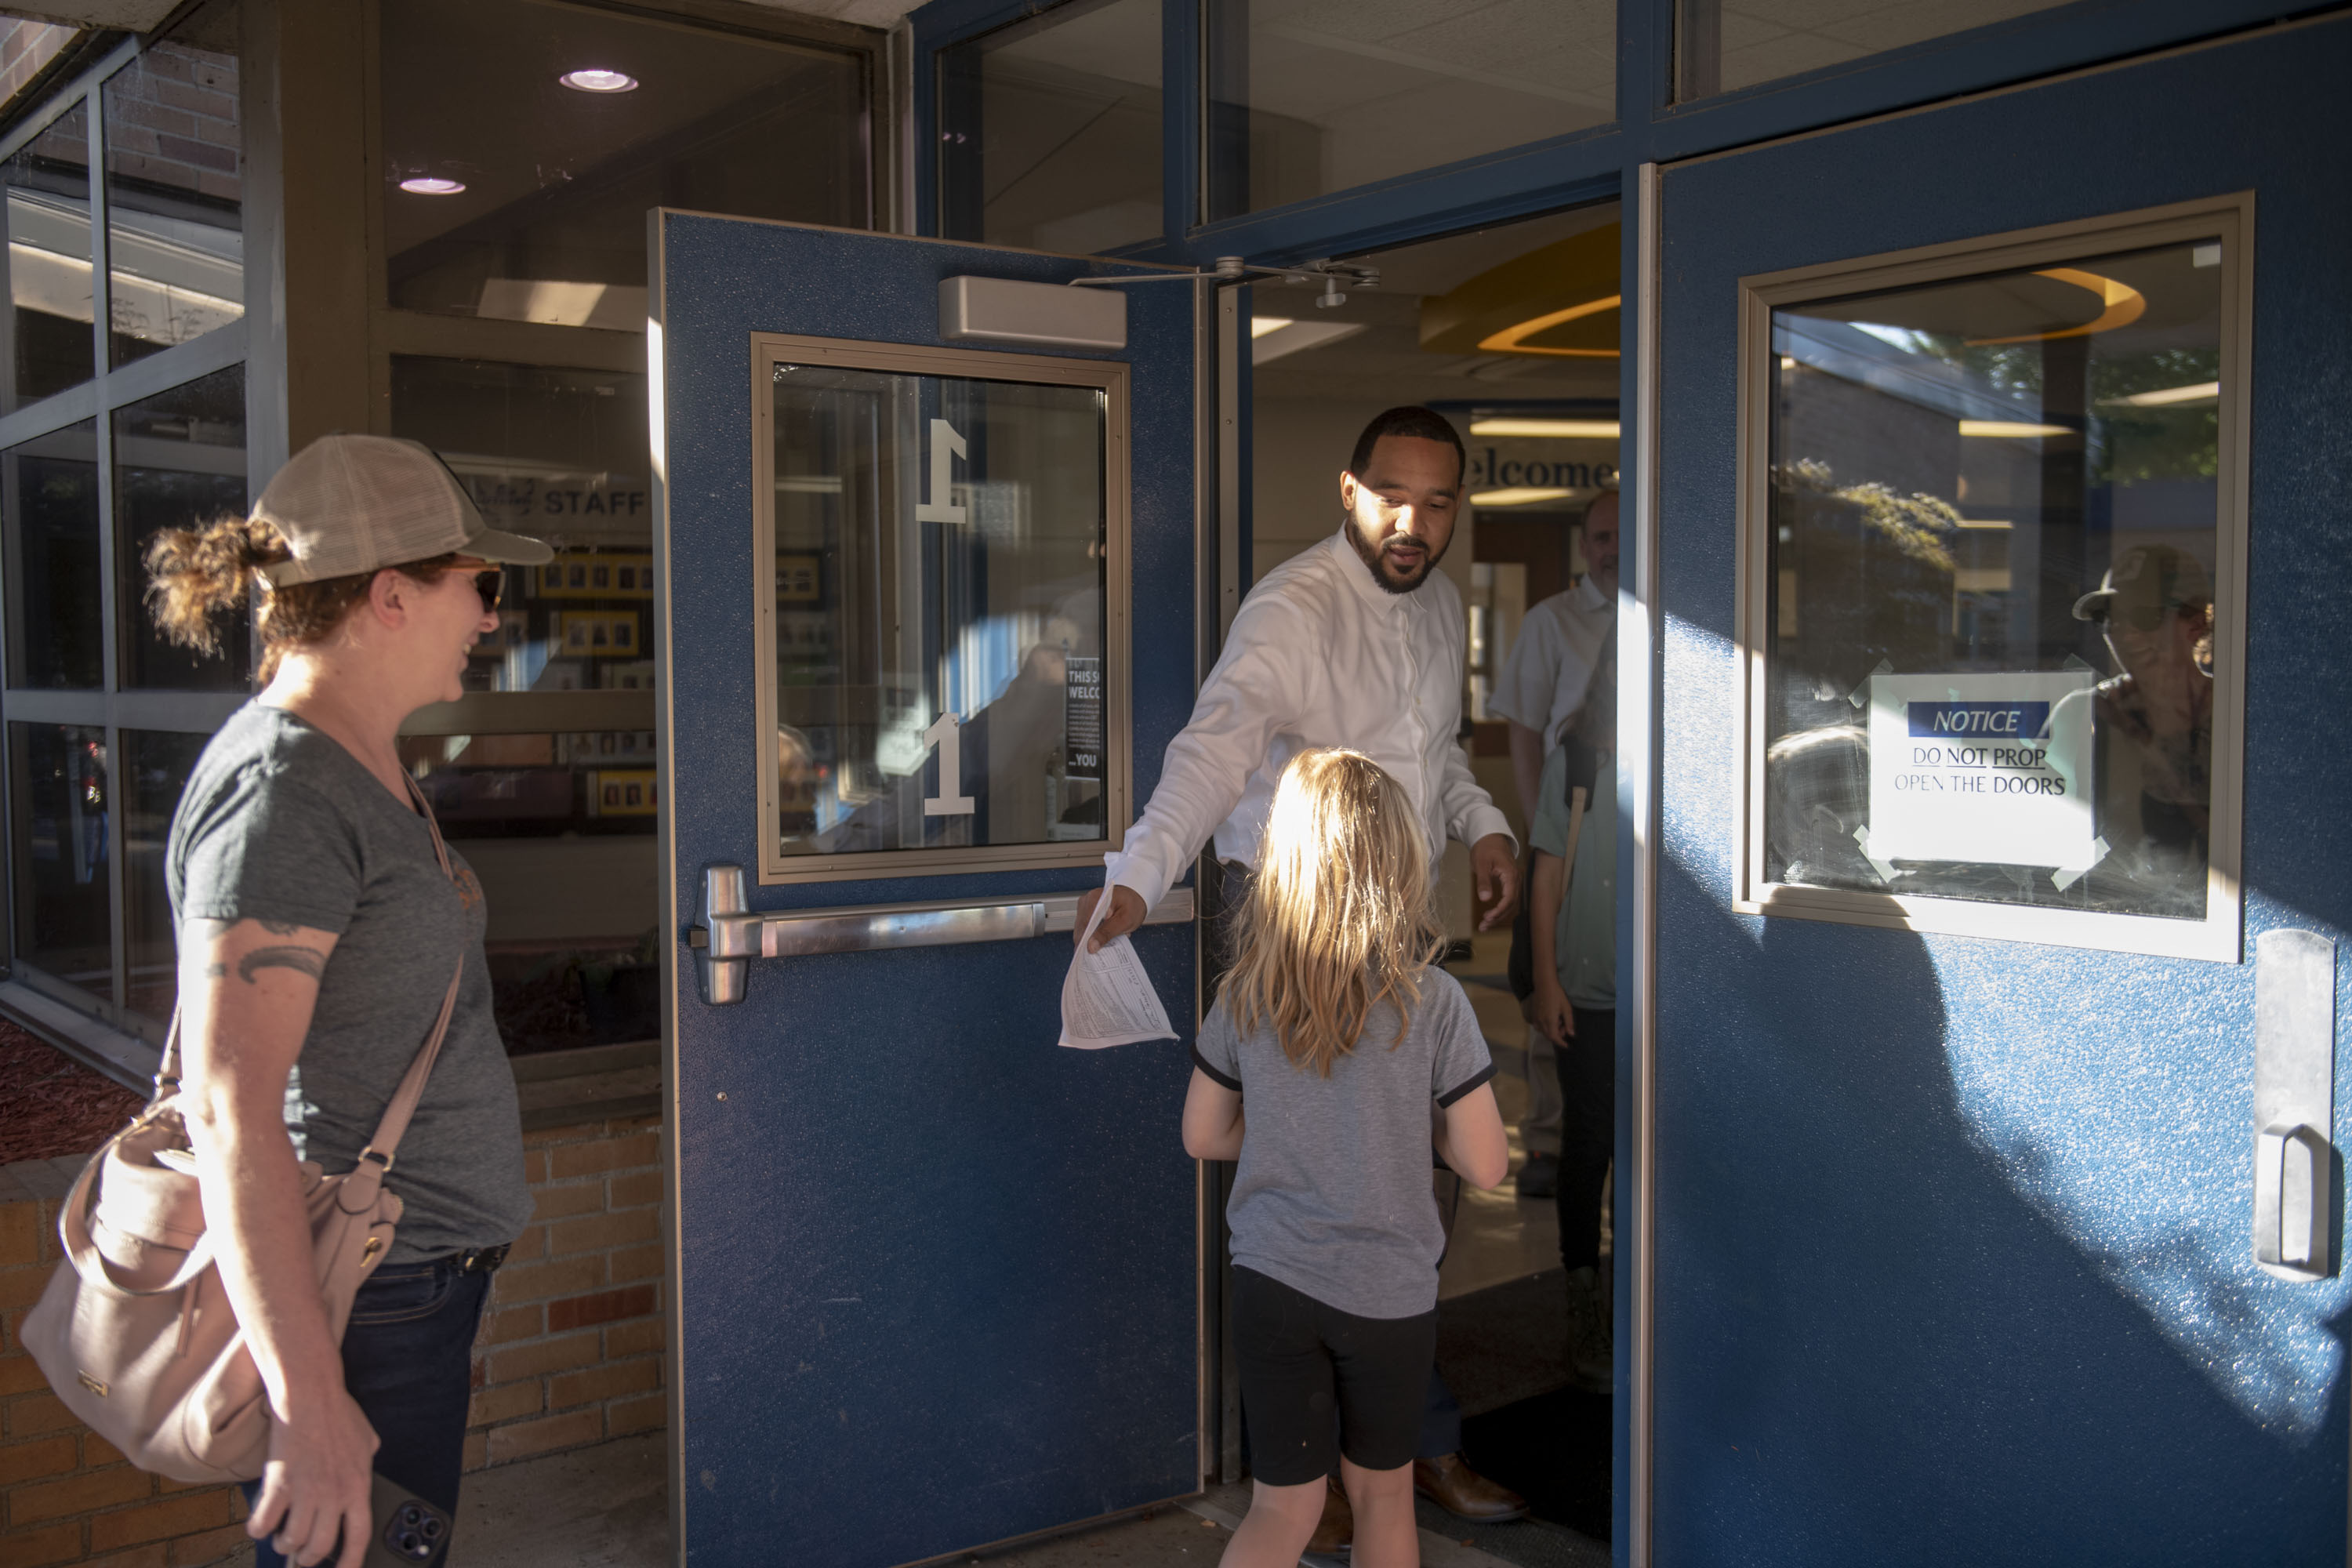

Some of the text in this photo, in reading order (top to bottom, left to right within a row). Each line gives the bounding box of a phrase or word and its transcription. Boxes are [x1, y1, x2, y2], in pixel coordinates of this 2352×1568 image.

[545, 491, 645, 515] STAFF
[1068, 670, 1100, 684] THIS S
[1933, 710, 2022, 733] NOTICE
[924, 712, 975, 815] 1
[1913, 747, 2046, 768] DO NOT PROP
[1894, 774, 2066, 796] OPEN THE DOORS
